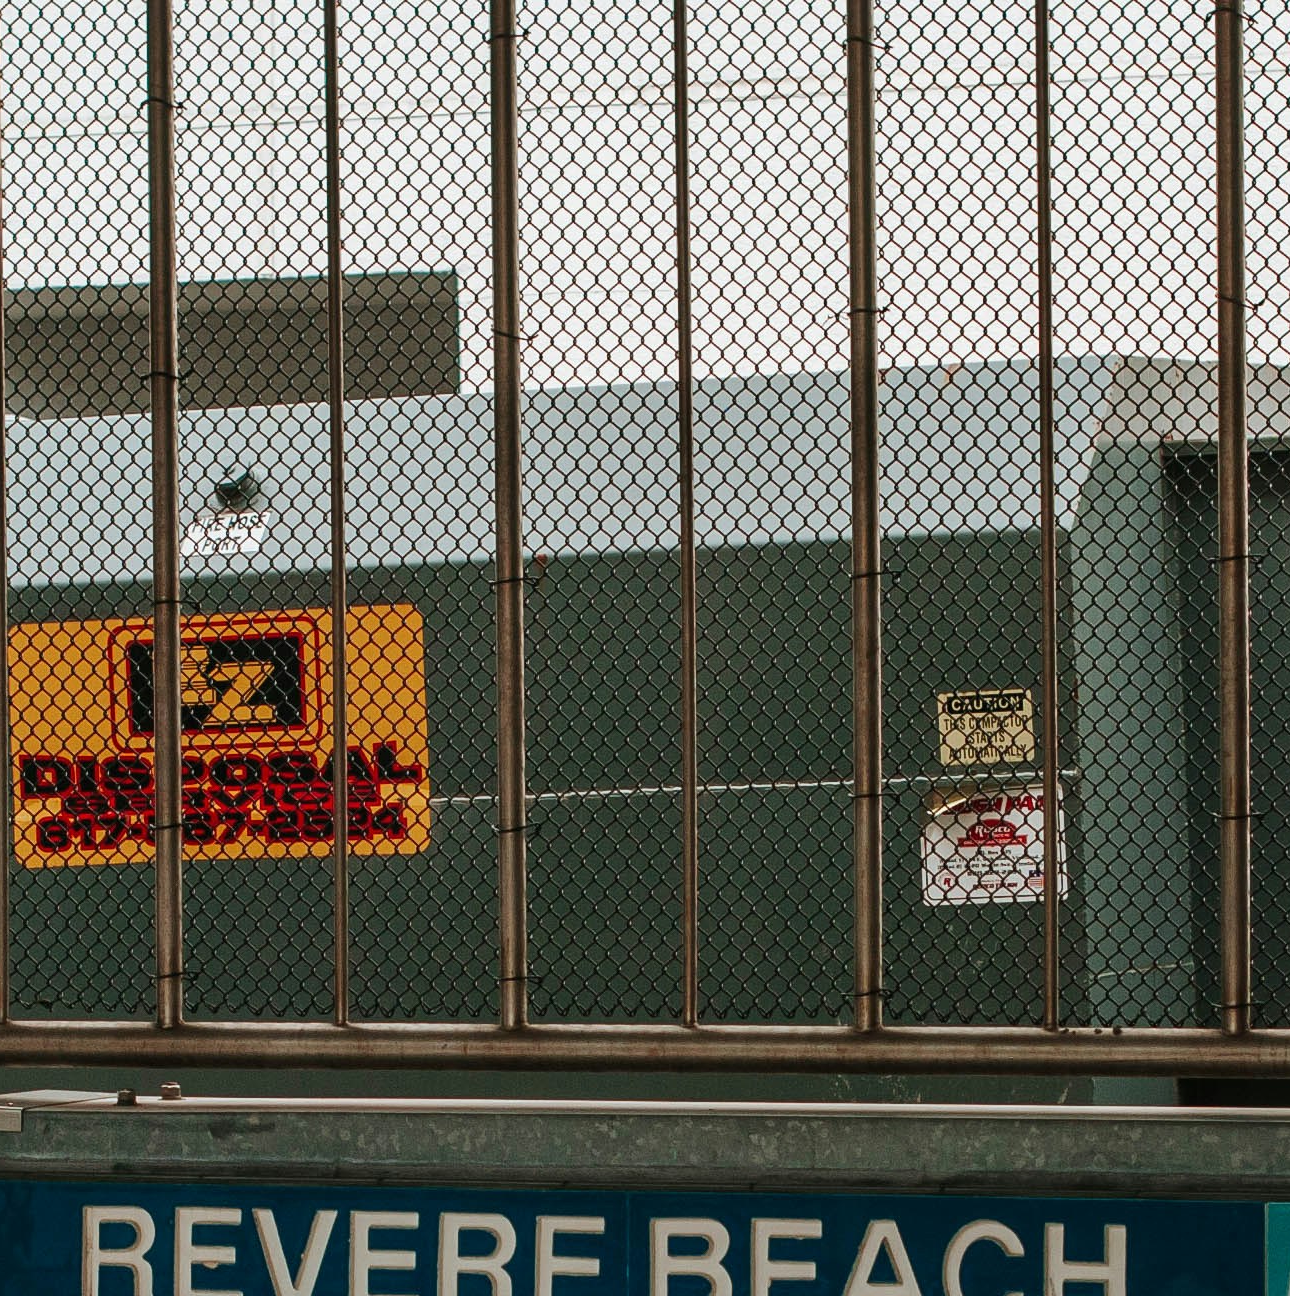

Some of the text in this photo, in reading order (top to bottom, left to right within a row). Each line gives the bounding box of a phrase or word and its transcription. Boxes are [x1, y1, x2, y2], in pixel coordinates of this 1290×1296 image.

[951, 695, 1020, 712] CAUTION
[943, 717, 966, 731] THS
[19, 741, 421, 800] DISPOSAL
[36, 801, 407, 853] 617-67-2524
